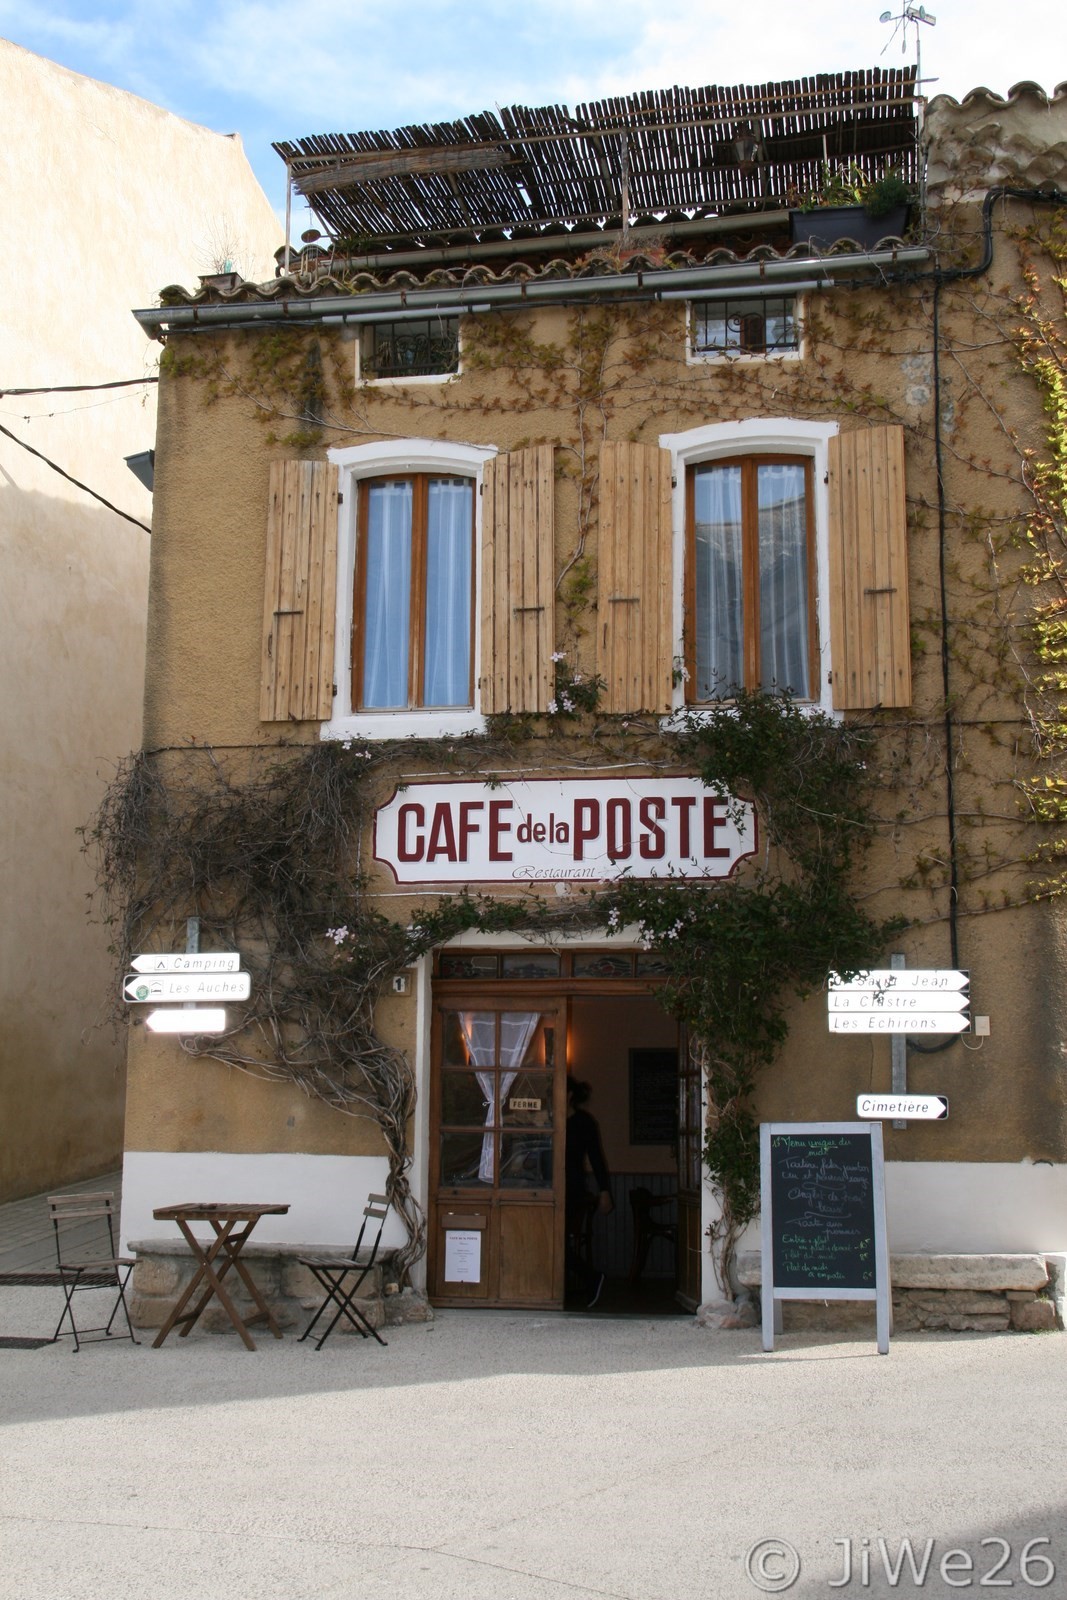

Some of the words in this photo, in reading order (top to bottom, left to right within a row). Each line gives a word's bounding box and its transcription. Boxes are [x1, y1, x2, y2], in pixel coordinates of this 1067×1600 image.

[398, 800, 513, 862] CAFE
[573, 796, 731, 860] POSTE
[512, 865, 595, 878] Restaurant
[174, 957, 234, 971] Camping
[395, 977, 402, 991] 1
[911, 975, 948, 987] Jean
[169, 983, 189, 994] Les
[197, 982, 244, 993] Auches
[834, 996, 849, 1007] La
[834, 1017, 858, 1029] Les
[868, 1017, 937, 1029] Echirons
[513, 1101, 538, 1109] FERME
[862, 1100, 929, 1113] Cimetière
